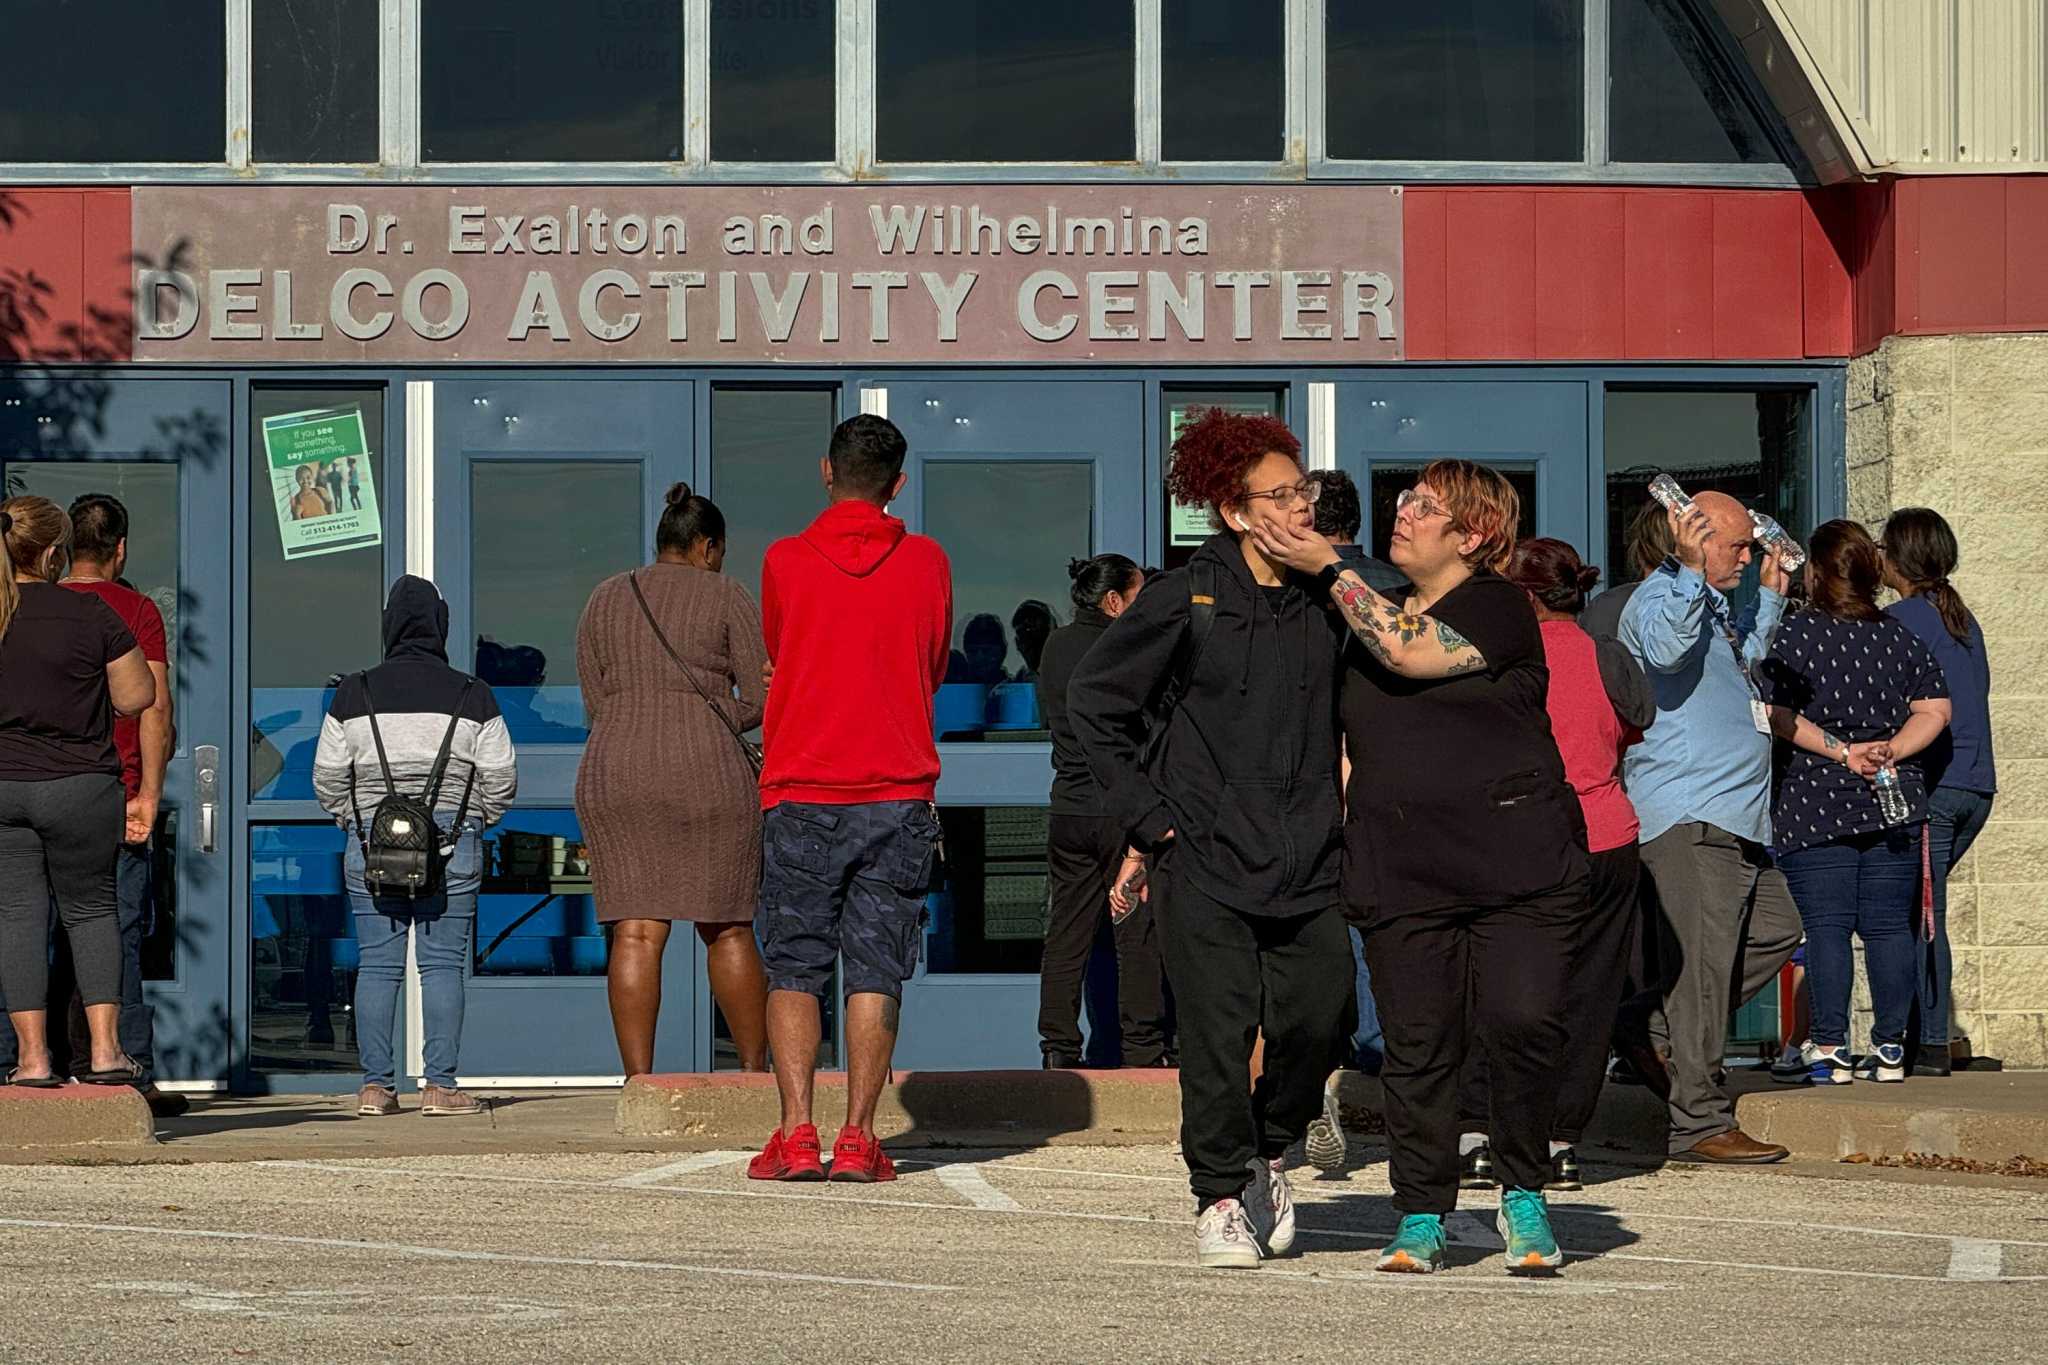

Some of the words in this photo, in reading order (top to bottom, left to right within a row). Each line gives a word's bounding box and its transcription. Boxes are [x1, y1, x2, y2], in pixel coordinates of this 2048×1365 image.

[327, 203, 413, 254] Dr.
[449, 204, 687, 255] Exalton
[723, 206, 834, 255] and
[868, 204, 1209, 255] Wilhelmina
[137, 266, 471, 342] DELCO
[506, 268, 979, 342] ACTIVITY
[1016, 269, 1397, 342] CENTER
[301, 429, 315, 441] you
[316, 426, 333, 436] see
[287, 451, 303, 461] say
[300, 528, 312, 536] Call
